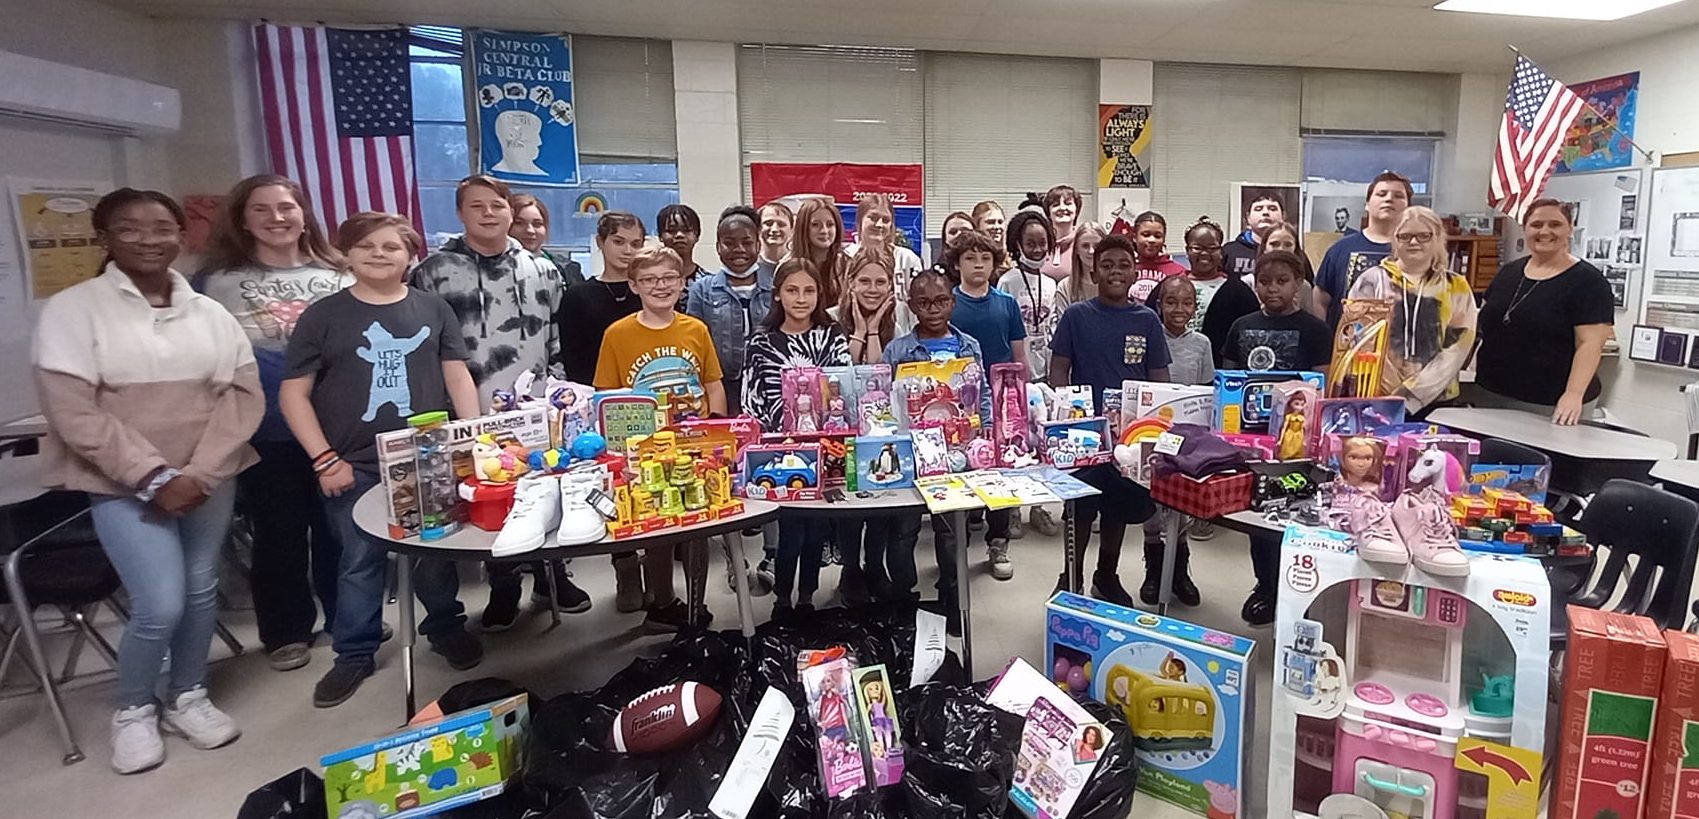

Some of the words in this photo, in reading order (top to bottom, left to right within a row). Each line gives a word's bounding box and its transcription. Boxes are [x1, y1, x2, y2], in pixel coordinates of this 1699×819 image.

[482, 36, 551, 53] SIMPSON
[484, 52, 553, 68] CENTRAL
[478, 63, 492, 76] JR
[497, 67, 534, 81] BETA
[537, 69, 571, 83] CLUB
[1107, 119, 1144, 128] ALWAYS
[1106, 129, 1135, 137] LIGHT
[1111, 145, 1125, 153] SEE
[1123, 175, 1133, 183] BE
[378, 359, 401, 370] HUG
[626, 352, 653, 386] CATCH
[654, 346, 677, 356] THE
[377, 375, 401, 388] OUT
[453, 426, 473, 440] IN
[1055, 454, 1074, 464] KID
[1293, 554, 1313, 569] 18
[1052, 615, 1082, 641] Peppa
[1083, 625, 1099, 650] Pig
[1577, 648, 1595, 681] TREE
[1676, 665, 1697, 699] TREE
[833, 759, 862, 775] Barbie
[1591, 756, 1618, 766] green
[1619, 761, 1638, 770] tree
